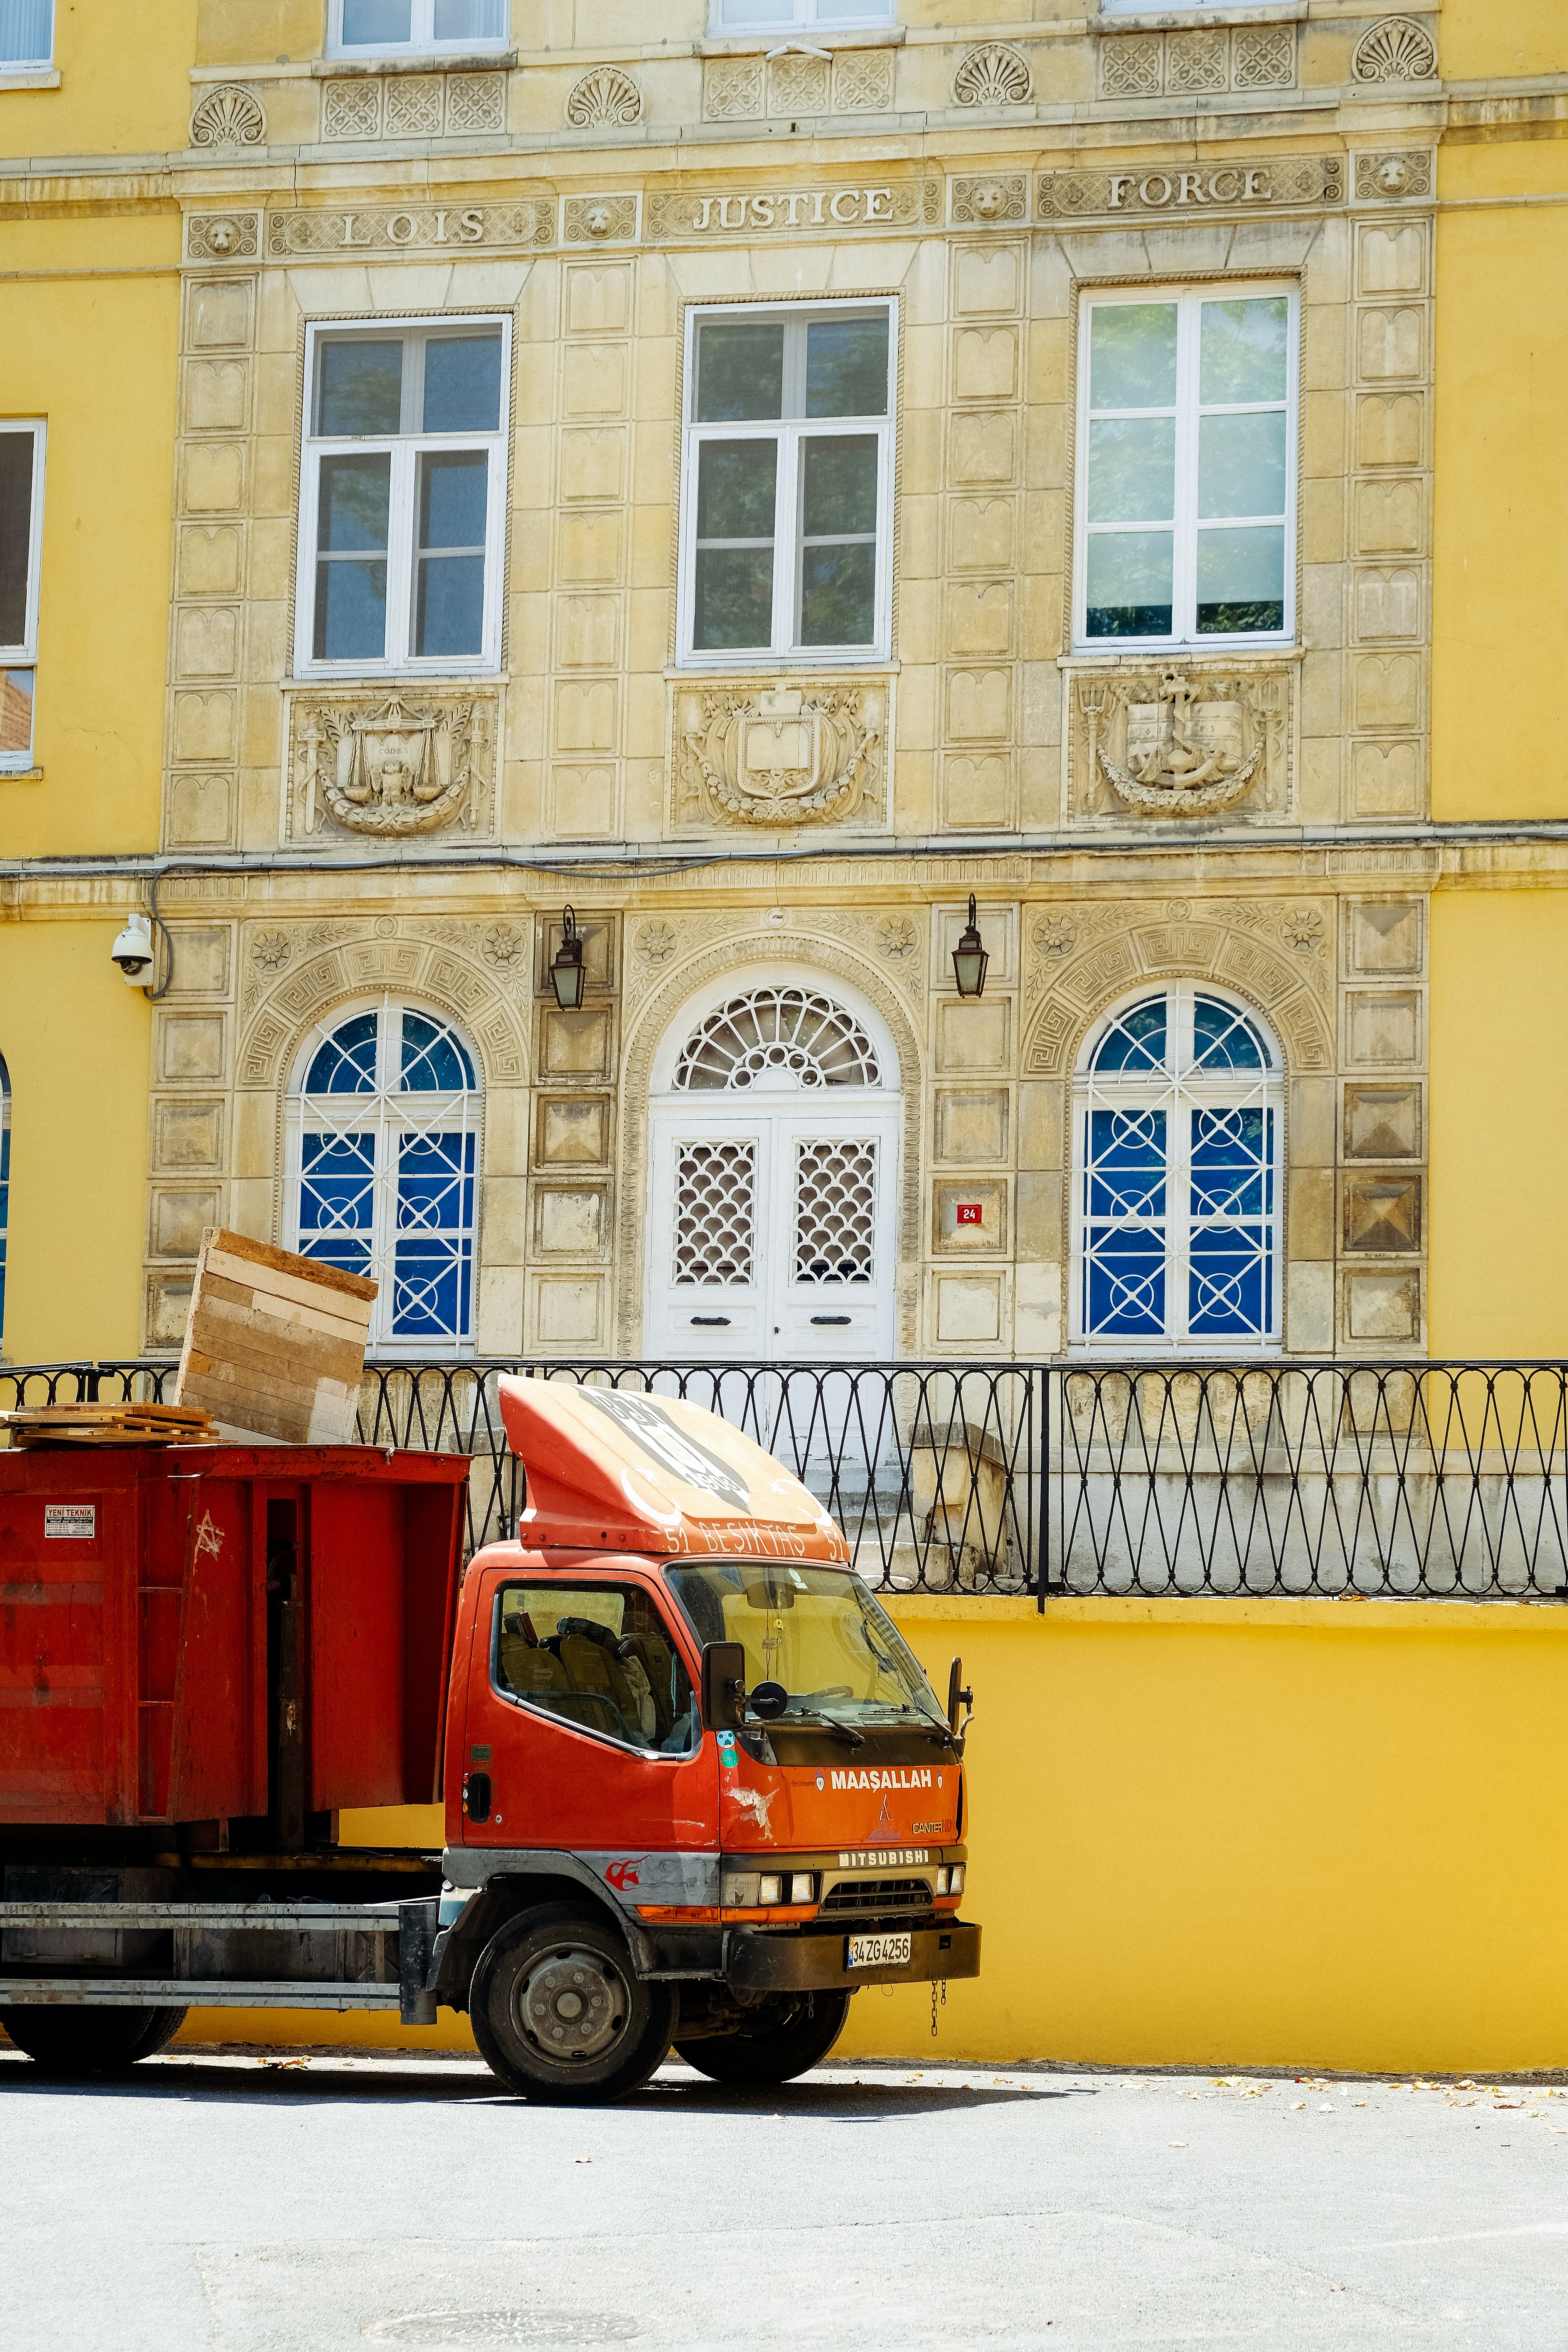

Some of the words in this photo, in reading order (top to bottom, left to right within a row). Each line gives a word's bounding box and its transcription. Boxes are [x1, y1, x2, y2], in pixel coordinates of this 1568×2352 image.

[1107, 168, 1272, 209] FORCE
[693, 188, 894, 229] JUSTICE
[339, 209, 483, 246] LOIS
[964, 1209, 975, 1219] 24
[595, 1395, 665, 1427] BJK
[685, 1473, 741, 1492] 1903
[49, 1508, 64, 1516] YENİ
[66, 1508, 92, 1516] TEKNİK
[664, 1527, 691, 1553] 51
[823, 1530, 845, 1561] 51
[831, 1770, 931, 1793] MAAŞALLAH
[839, 1850, 929, 1867] MITSUBISHI
[854, 1941, 864, 1962] 34
[866, 1939, 881, 1961] ZG
[882, 1938, 909, 1960] 4256
